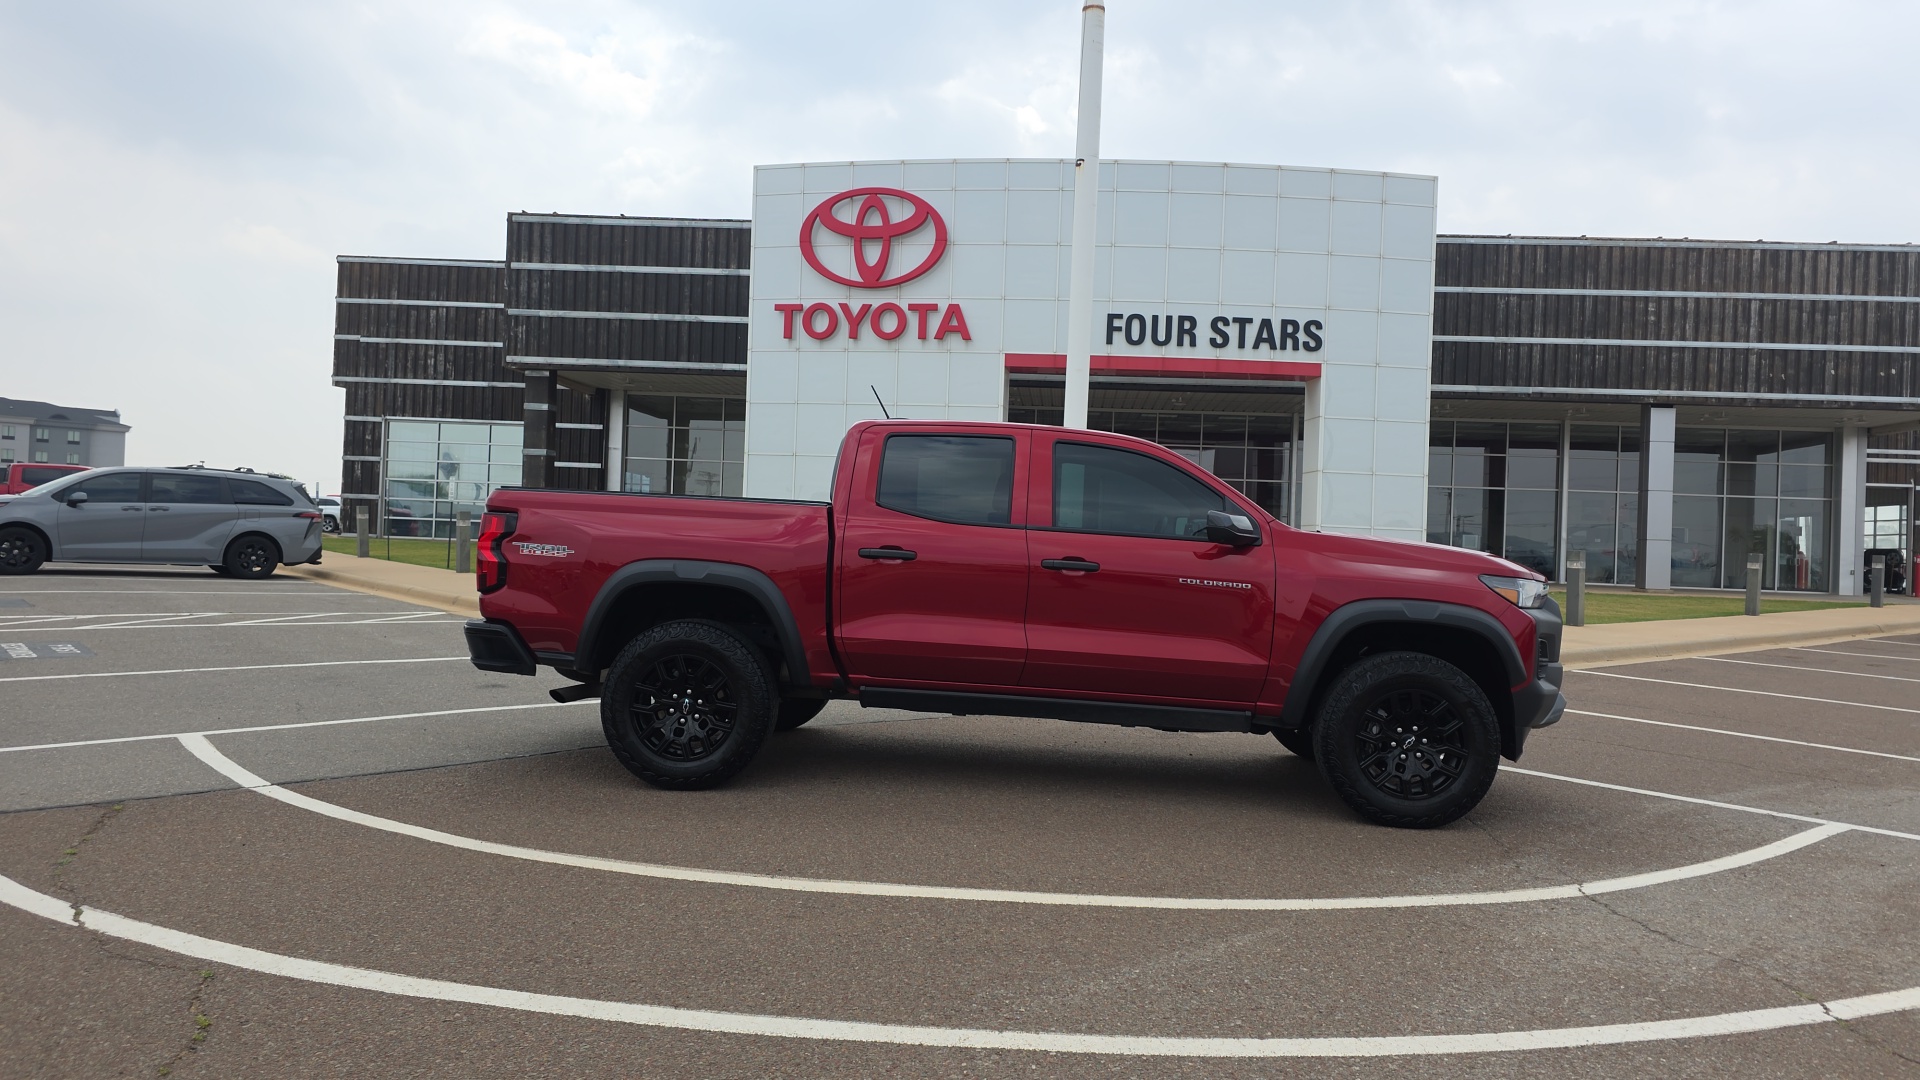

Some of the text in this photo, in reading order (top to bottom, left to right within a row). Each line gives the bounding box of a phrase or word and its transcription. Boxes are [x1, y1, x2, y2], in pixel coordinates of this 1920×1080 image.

[774, 302, 972, 341] TOYOTA
[1106, 313, 1324, 352] FOUR STARS
[1179, 578, 1252, 589] COLORADO
